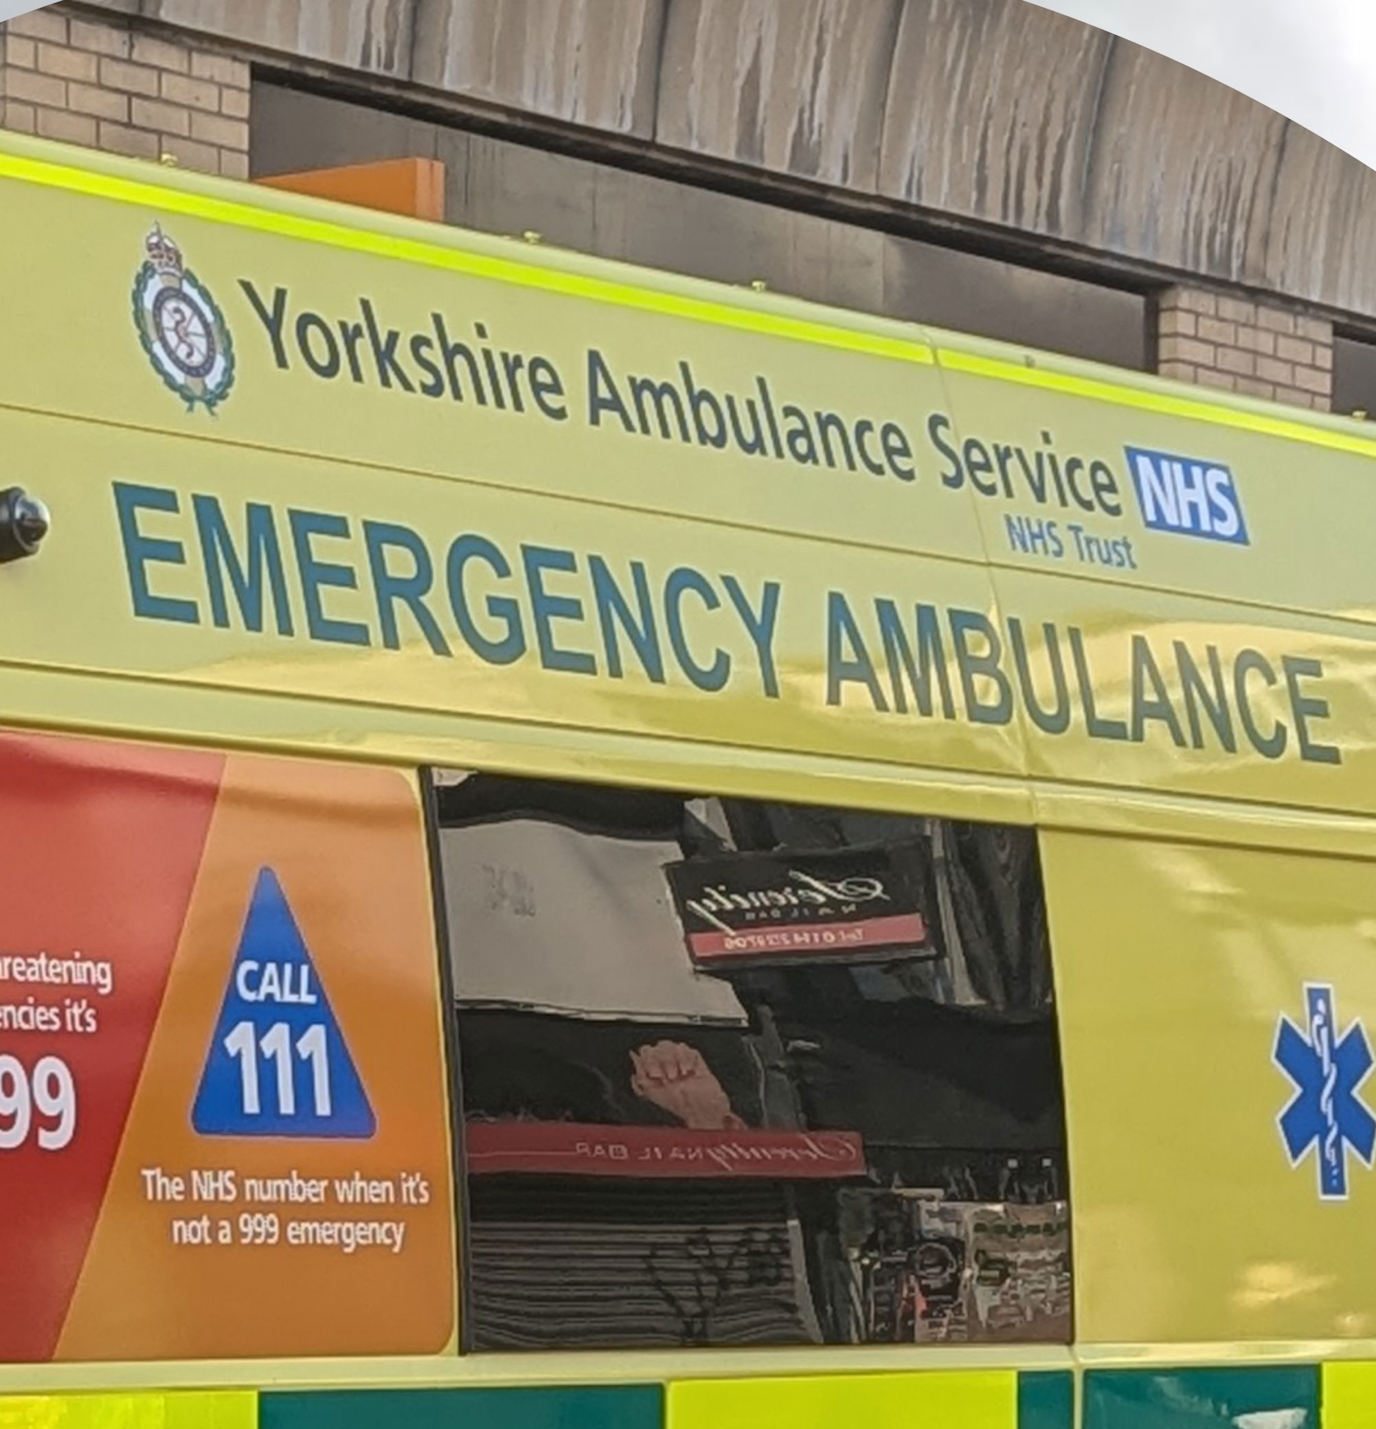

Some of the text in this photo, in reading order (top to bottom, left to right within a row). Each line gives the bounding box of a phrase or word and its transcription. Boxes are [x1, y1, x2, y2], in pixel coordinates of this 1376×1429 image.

[238, 279, 568, 422] Yorkshire
[588, 349, 916, 483] Ambulance
[927, 412, 1123, 517] Service
[1135, 454, 1240, 538] NHS
[1004, 513, 1138, 569] NHS Trust
[112, 481, 1343, 766] EMERGENCY AMBULANCE
[235, 960, 318, 1005] CALL
[0, 996, 97, 1033] ncies it's
[223, 1021, 332, 1117] 111
[141, 1167, 430, 1205] The NHS number when it's
[172, 1212, 406, 1254] not a 999 emergency
